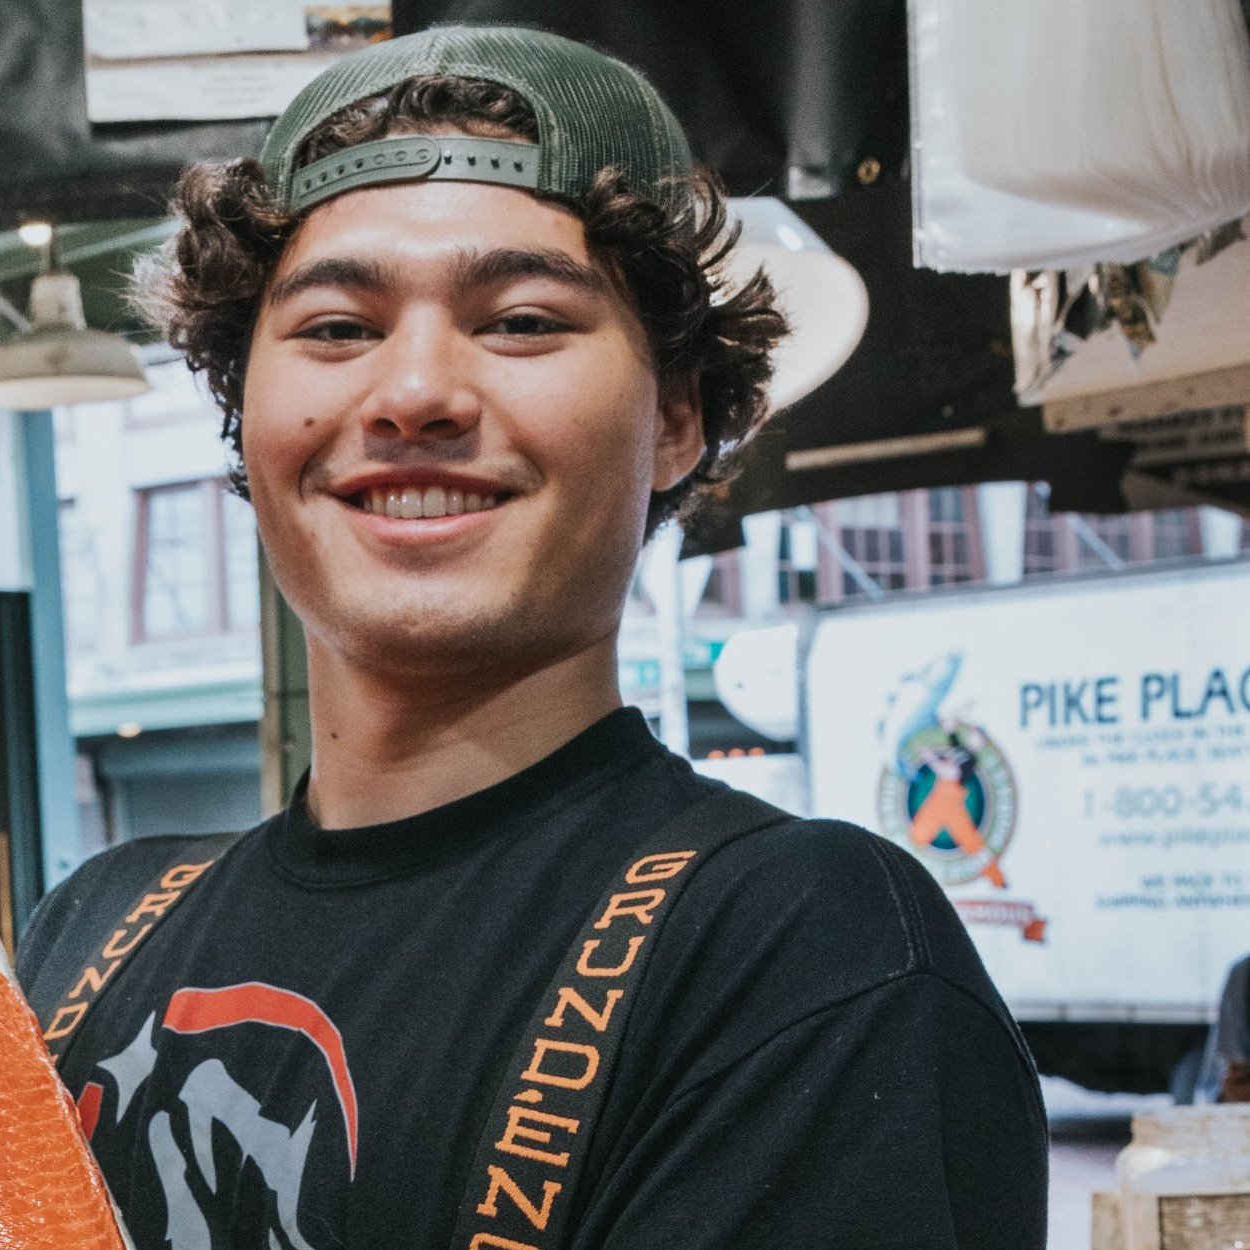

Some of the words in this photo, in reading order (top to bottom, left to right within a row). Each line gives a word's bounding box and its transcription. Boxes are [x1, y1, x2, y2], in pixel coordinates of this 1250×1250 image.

[1019, 676, 1120, 729] PIKE
[1083, 782, 1250, 820] 1-800-54
[42, 859, 215, 1042] GRUND
